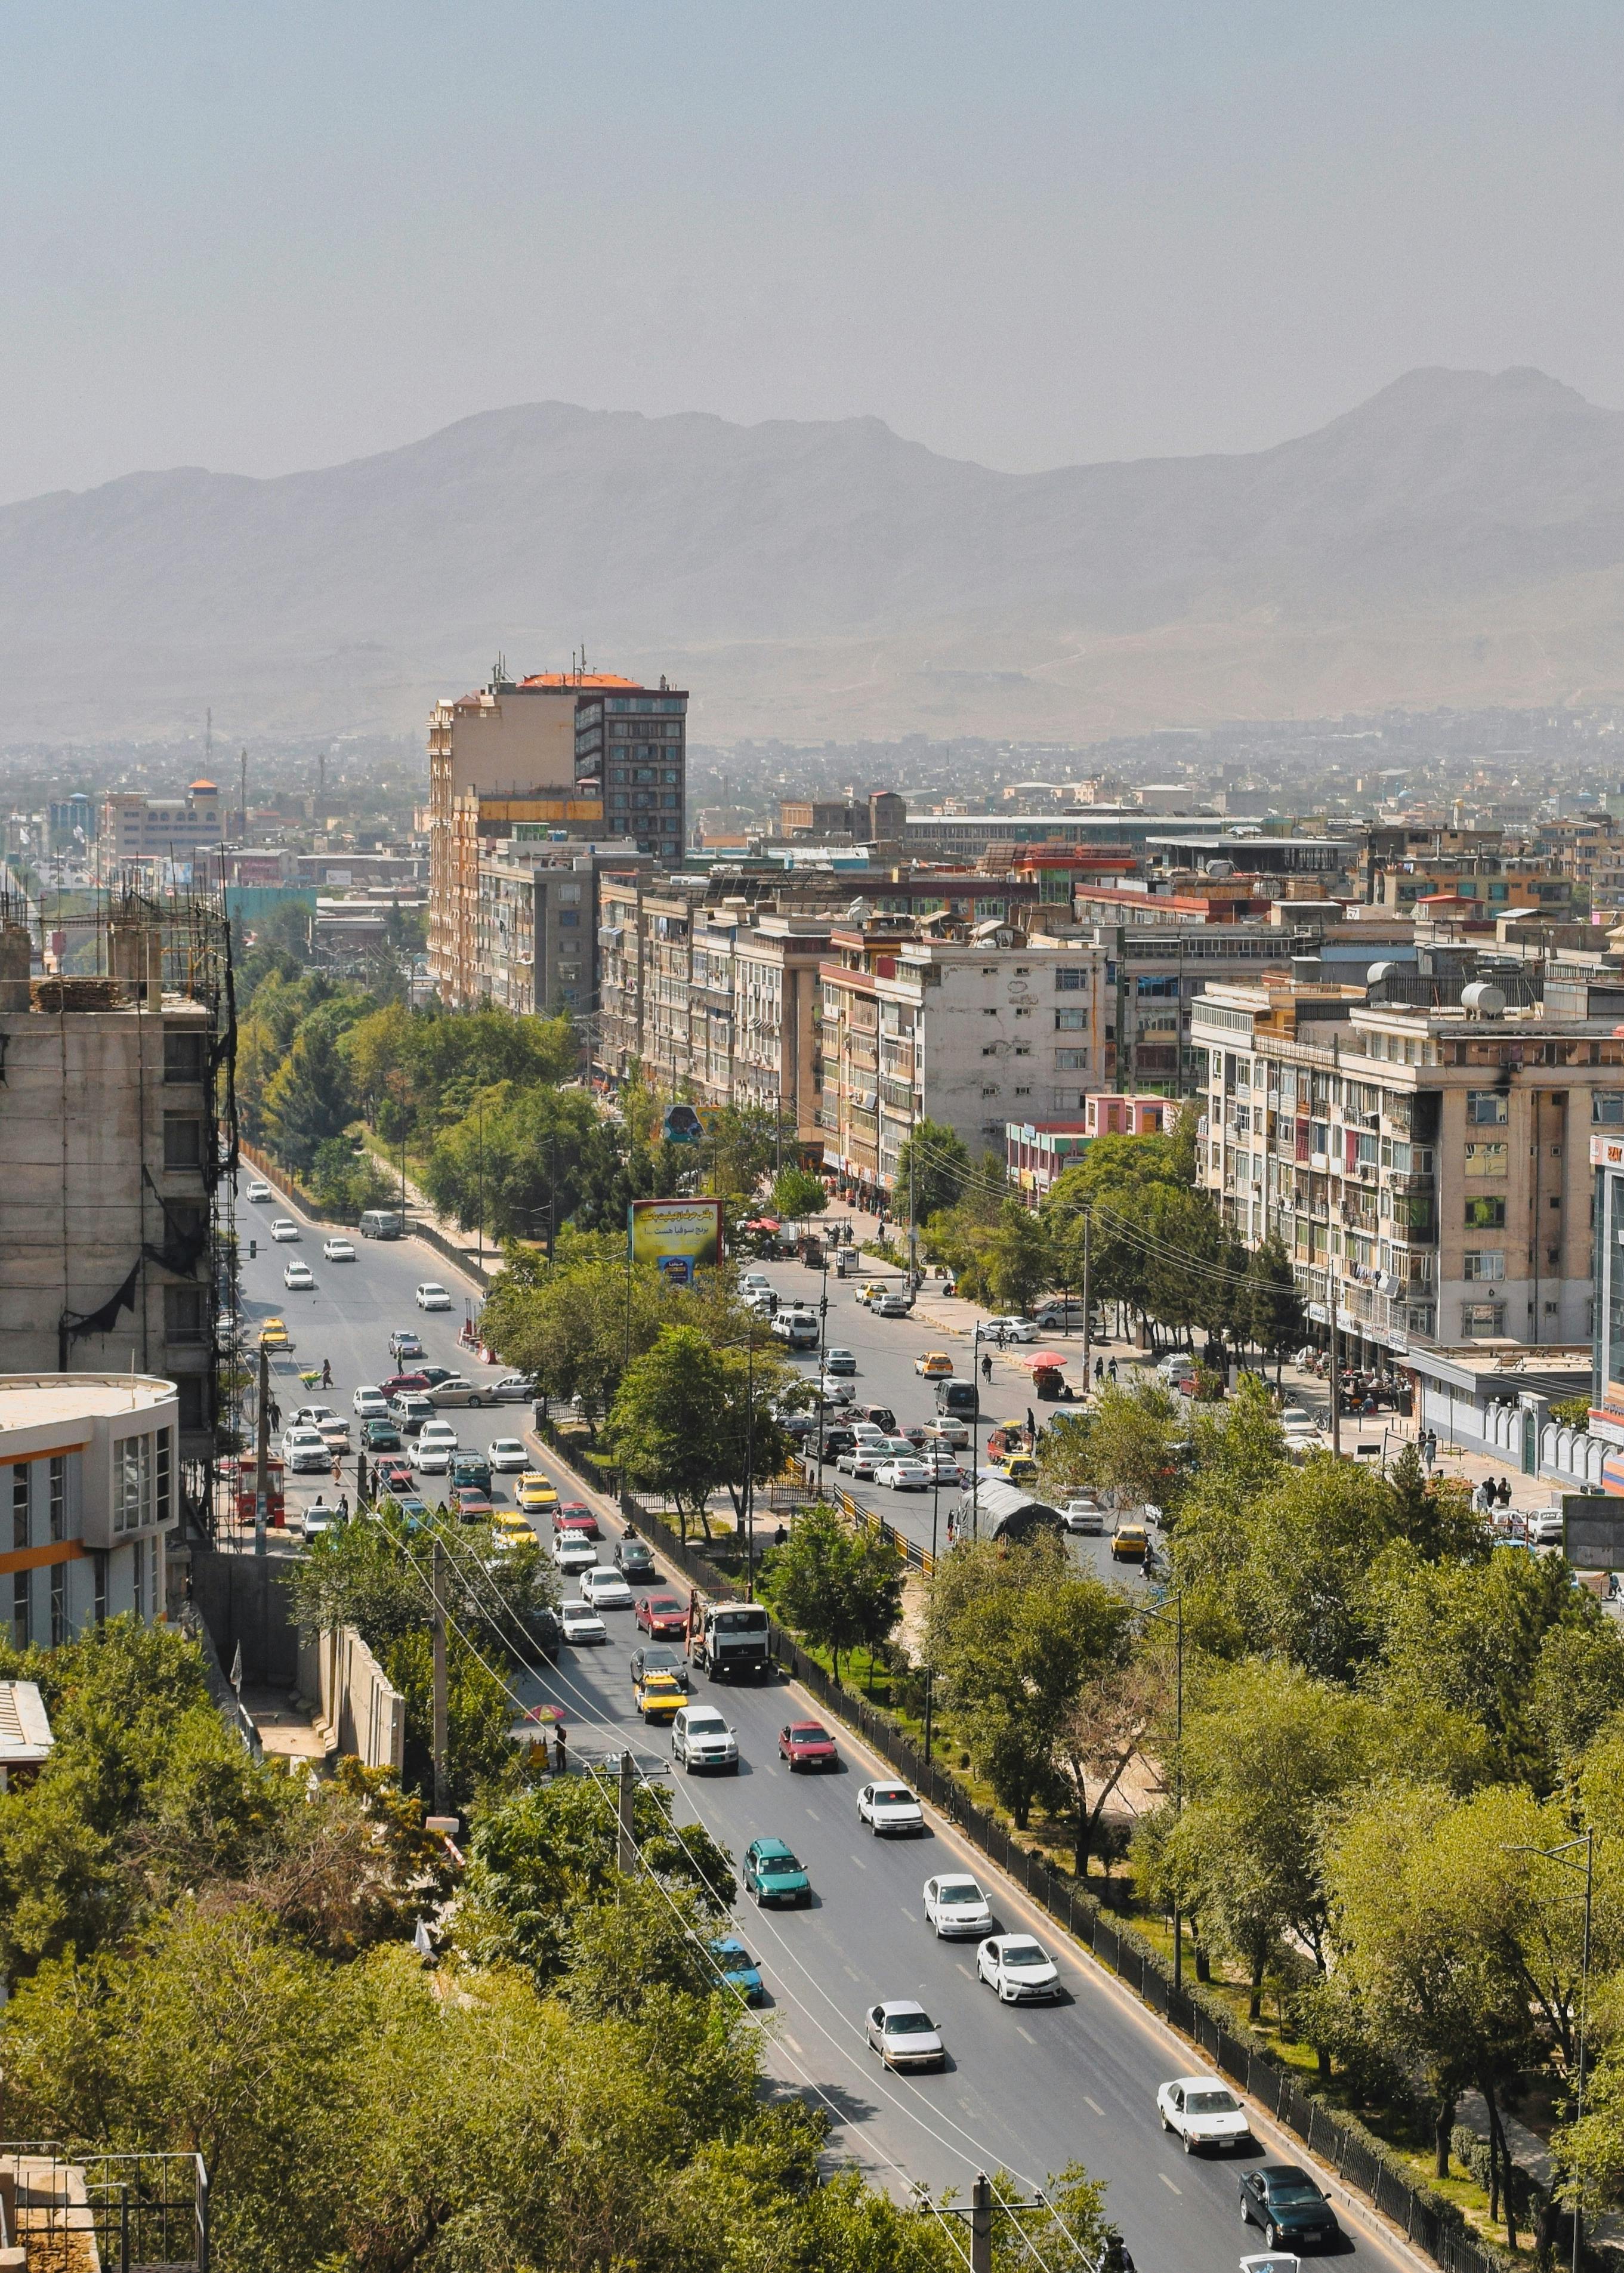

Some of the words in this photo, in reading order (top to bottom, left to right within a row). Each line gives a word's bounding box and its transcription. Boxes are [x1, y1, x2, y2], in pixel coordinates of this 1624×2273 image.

[659, 1211, 678, 1222] کیفیت
[684, 1209, 697, 1221] حرف
[697, 1208, 714, 1221] وقتی
[674, 1225, 694, 1235] سوفیا
[695, 1226, 709, 1235] برنج
